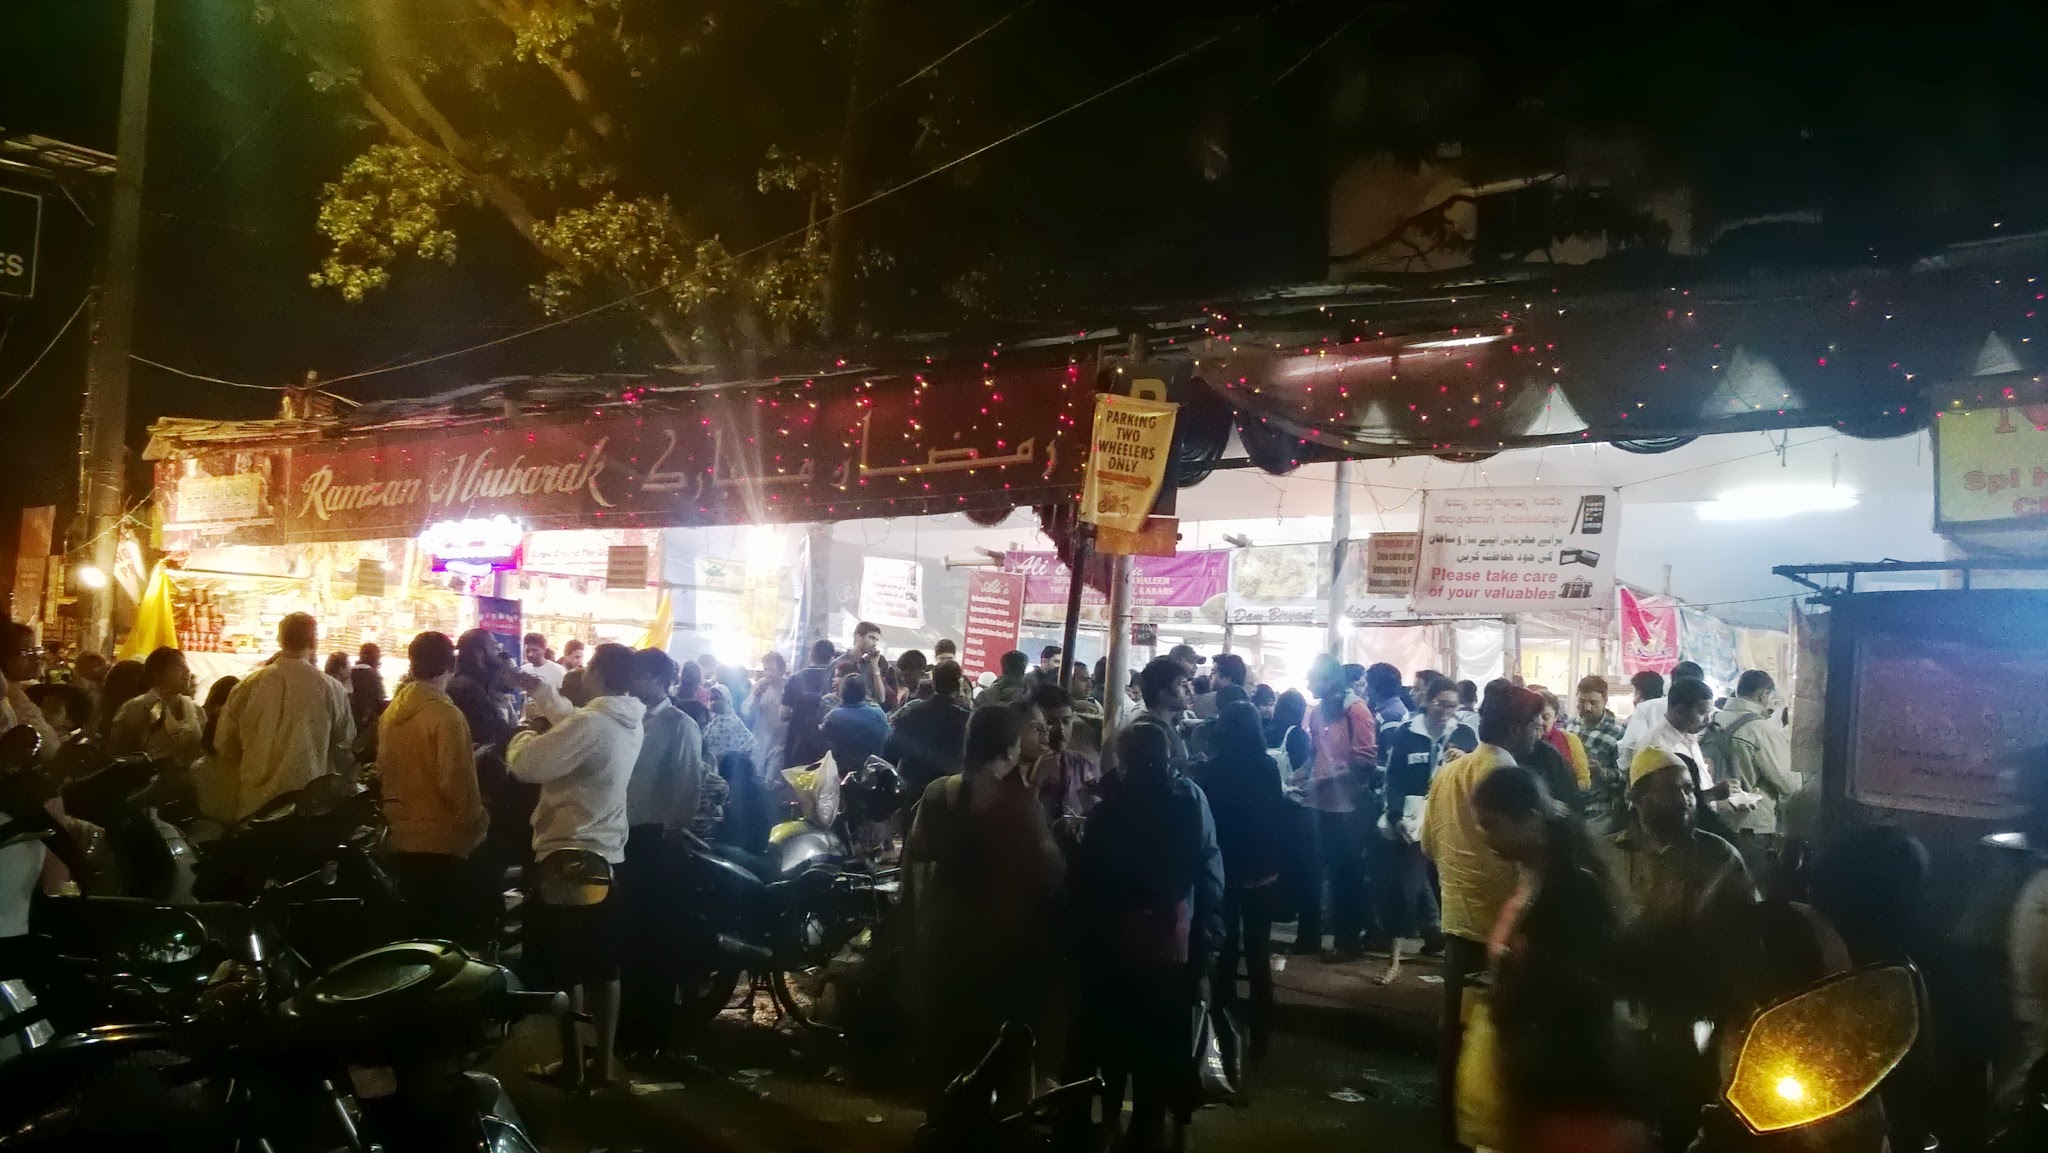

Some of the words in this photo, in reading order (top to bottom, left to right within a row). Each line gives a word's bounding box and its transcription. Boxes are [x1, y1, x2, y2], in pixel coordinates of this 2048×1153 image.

[1106, 410, 1157, 429] PARKING
[1116, 427, 1140, 442] TWO
[1099, 440, 1155, 460] WHEELERS
[1108, 457, 1139, 473] ONLY
[298, 464, 421, 520] Ramzan
[429, 436, 616, 508] Mubarak
[1431, 567, 1480, 582] Please
[1486, 569, 1518, 582] take
[1523, 572, 1557, 583] care
[1429, 585, 1443, 598] of
[1448, 588, 1480, 601] your
[1484, 587, 1556, 600] valuables
[1345, 605, 1393, 620] hicken
